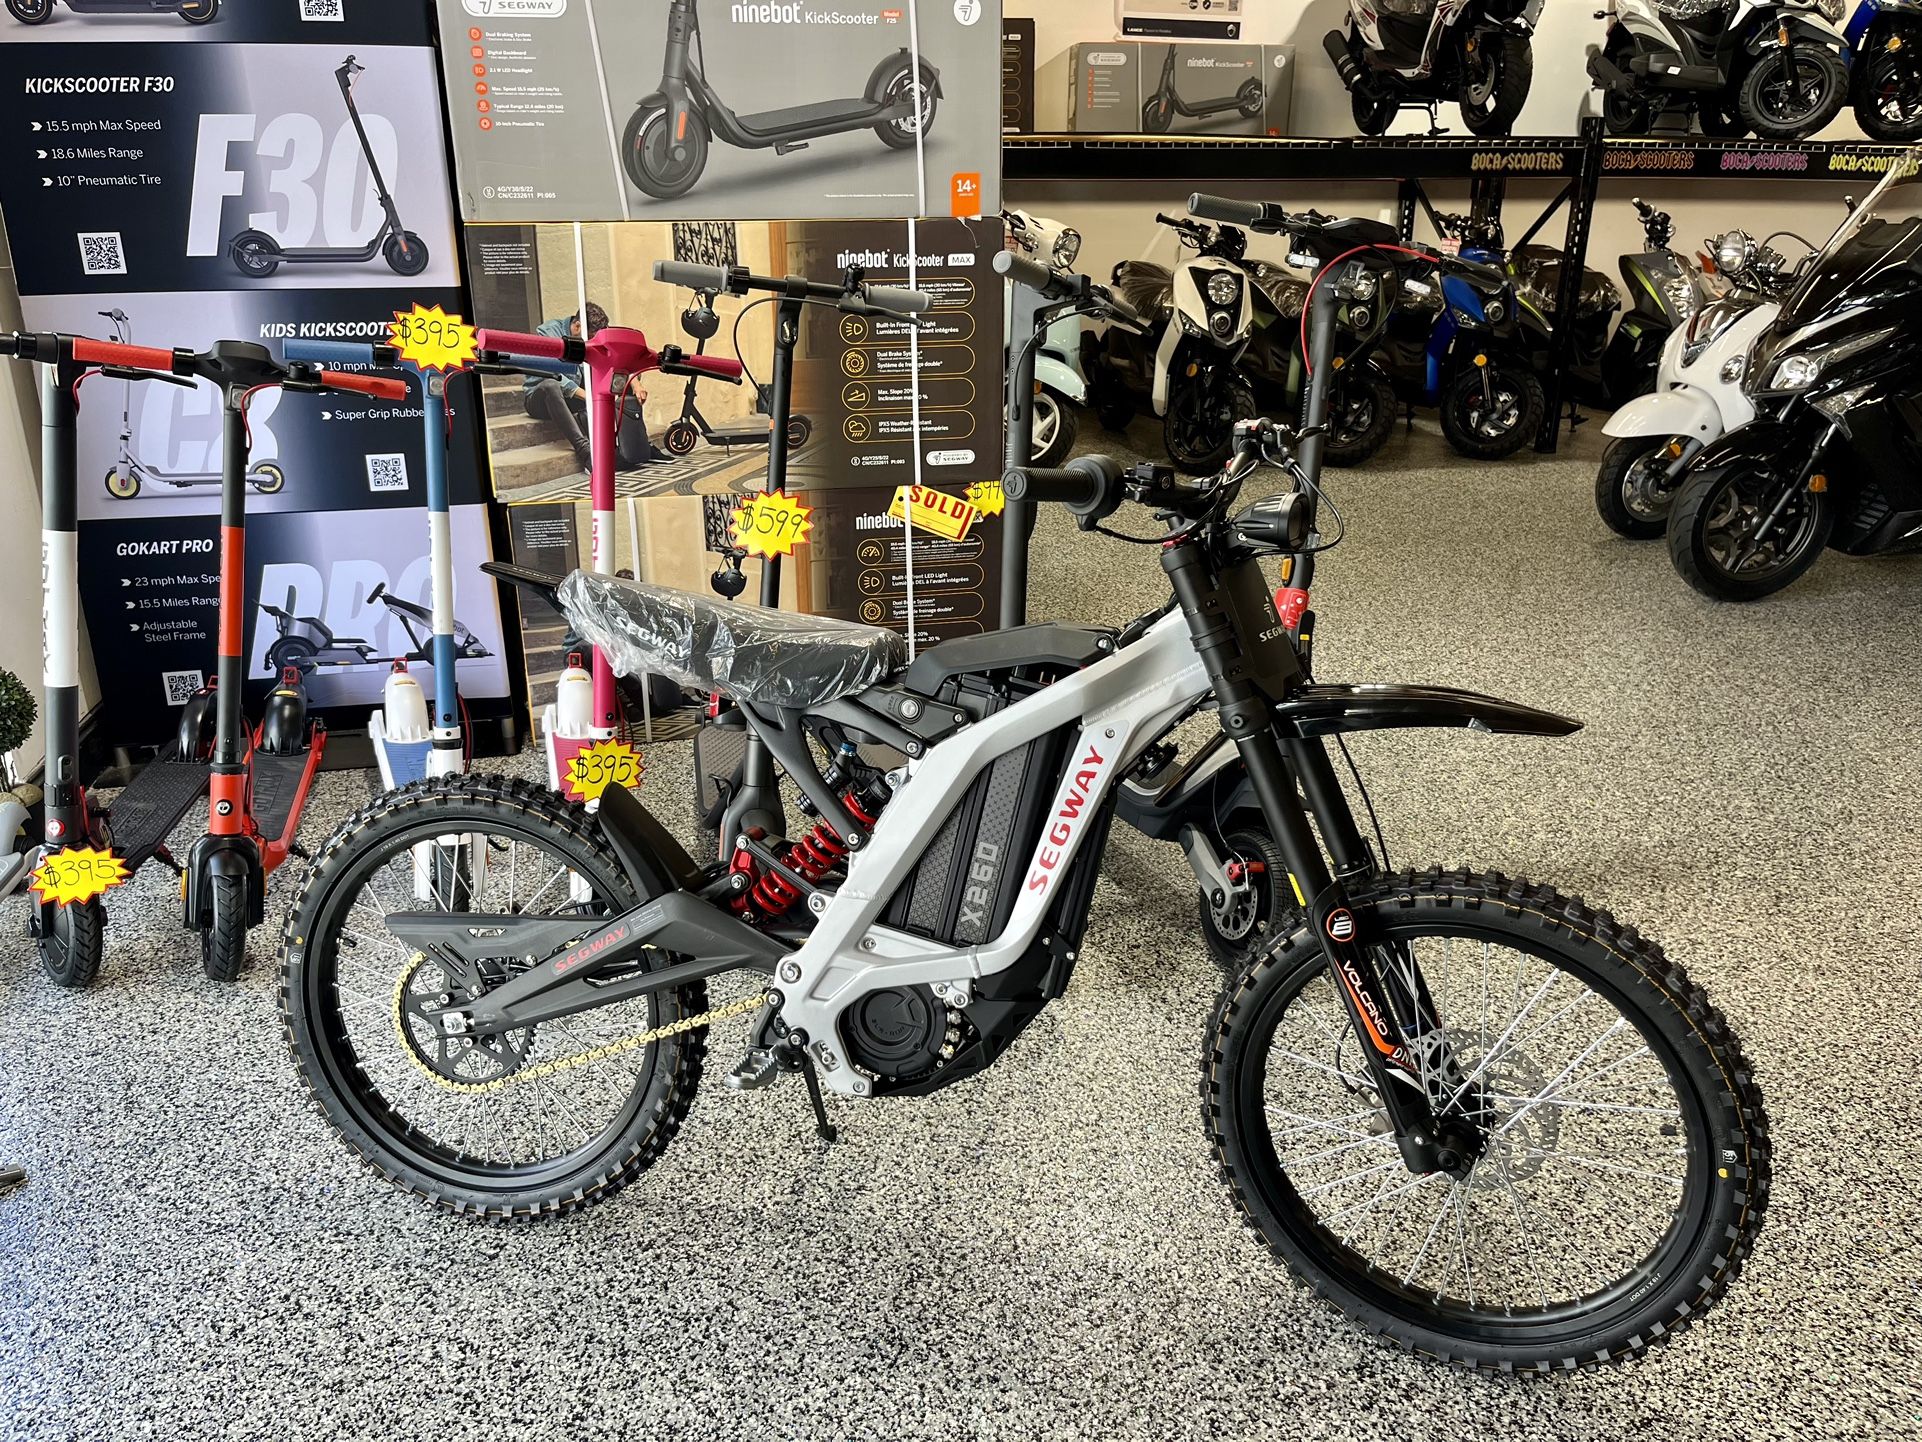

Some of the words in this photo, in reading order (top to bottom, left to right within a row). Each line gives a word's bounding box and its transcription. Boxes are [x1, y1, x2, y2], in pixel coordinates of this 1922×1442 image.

[498, 1, 553, 9] SEGWAY
[732, 0, 801, 24] ninebot
[805, 11, 879, 25] KickScooter
[1187, 57, 1215, 68] ninebot
[25, 77, 140, 94] KICKSCOOTER
[144, 76, 175, 92] F30
[46, 120, 69, 132] 15.5
[72, 120, 97, 133] mph
[99, 120, 124, 131] Max
[125, 119, 162, 133] Speed
[51, 148, 75, 160] 18.6
[76, 148, 107, 159] Miles
[108, 147, 144, 161] Range
[1471, 152, 1501, 170] BOCA
[1507, 152, 1564, 170] SCOOTERS
[1602, 151, 1634, 169] BOCA
[1638, 151, 1695, 169] SCOOTERS
[1720, 152, 1751, 170] BOCA
[1755, 152, 1809, 171] SCOOTERS
[1829, 154, 1857, 171] BOCA
[57, 175, 75, 187] 10"
[78, 175, 138, 186] Pneumatic
[139, 174, 162, 185] Tire
[186, 112, 399, 257] F30
[956, 179, 977, 193] 14+
[837, 249, 889, 269] ninebot
[952, 256, 971, 264] MAX
[260, 323, 296, 338] KIDS
[300, 321, 396, 337] KICKSCOOTE
[398, 316, 460, 347] $395
[329, 361, 341, 371] 10
[335, 410, 366, 421] Super
[368, 408, 390, 421] Grip
[392, 408, 425, 418] Rubbe
[736, 503, 803, 538] $599
[116, 541, 180, 556] GOKART
[182, 539, 214, 553] PRO
[135, 577, 149, 587] 23
[151, 576, 174, 587] mph
[176, 575, 199, 584] Max
[201, 573, 221, 585] Spe
[139, 599, 161, 609] 15.5
[162, 598, 190, 608] Miles
[143, 620, 198, 631] Adjustable
[1259, 625, 1284, 642] SEGW
[144, 632, 172, 643] Steel
[173, 631, 207, 641] Frame
[614, 616, 692, 659] SEGWAY
[574, 754, 636, 783] $395
[1028, 744, 1105, 896] SEGWAY
[42, 859, 116, 889] $395
[961, 842, 999, 928] X260
[554, 926, 625, 972] SEGWAY
[1343, 960, 1389, 1036] VOLCANO
